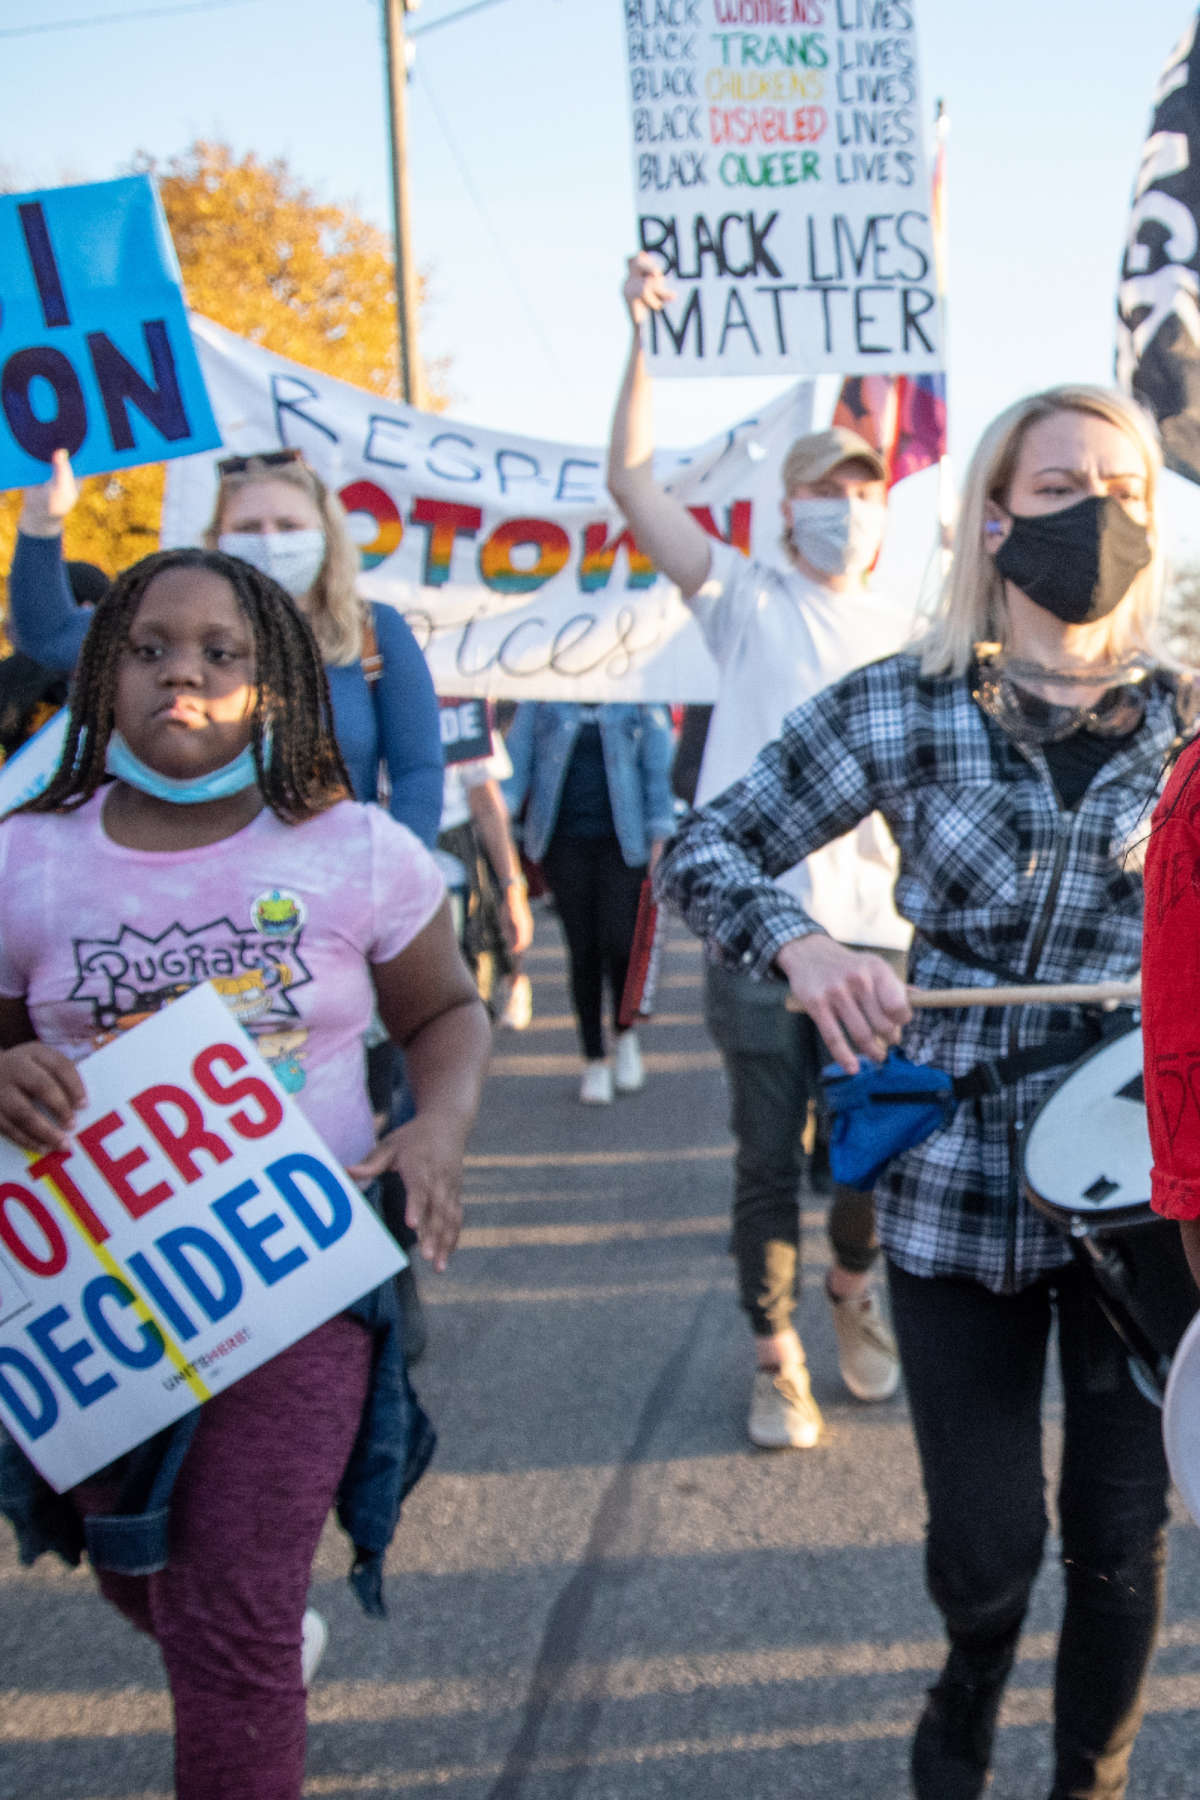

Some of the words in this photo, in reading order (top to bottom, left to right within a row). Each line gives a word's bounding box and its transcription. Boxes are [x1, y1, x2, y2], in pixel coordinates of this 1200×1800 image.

[836, 0, 914, 31] LIVES
[627, 32, 697, 63] BLACK
[711, 32, 829, 68] TRANS
[838, 38, 915, 70] LIVES
[630, 67, 699, 101] BLACK
[836, 70, 916, 104] LIVES
[633, 104, 702, 143] BLACK
[709, 105, 828, 145] DISABLED
[639, 151, 707, 191] BLACK
[719, 151, 822, 187] QUEER
[835, 152, 915, 186] LIVES
[640, 210, 783, 280] BLACK
[807, 211, 930, 283] LIVES
[648, 284, 937, 358] MATTER
[0, 1042, 284, 1278] OTERS
[0, 1152, 353, 1442] DECIDED
